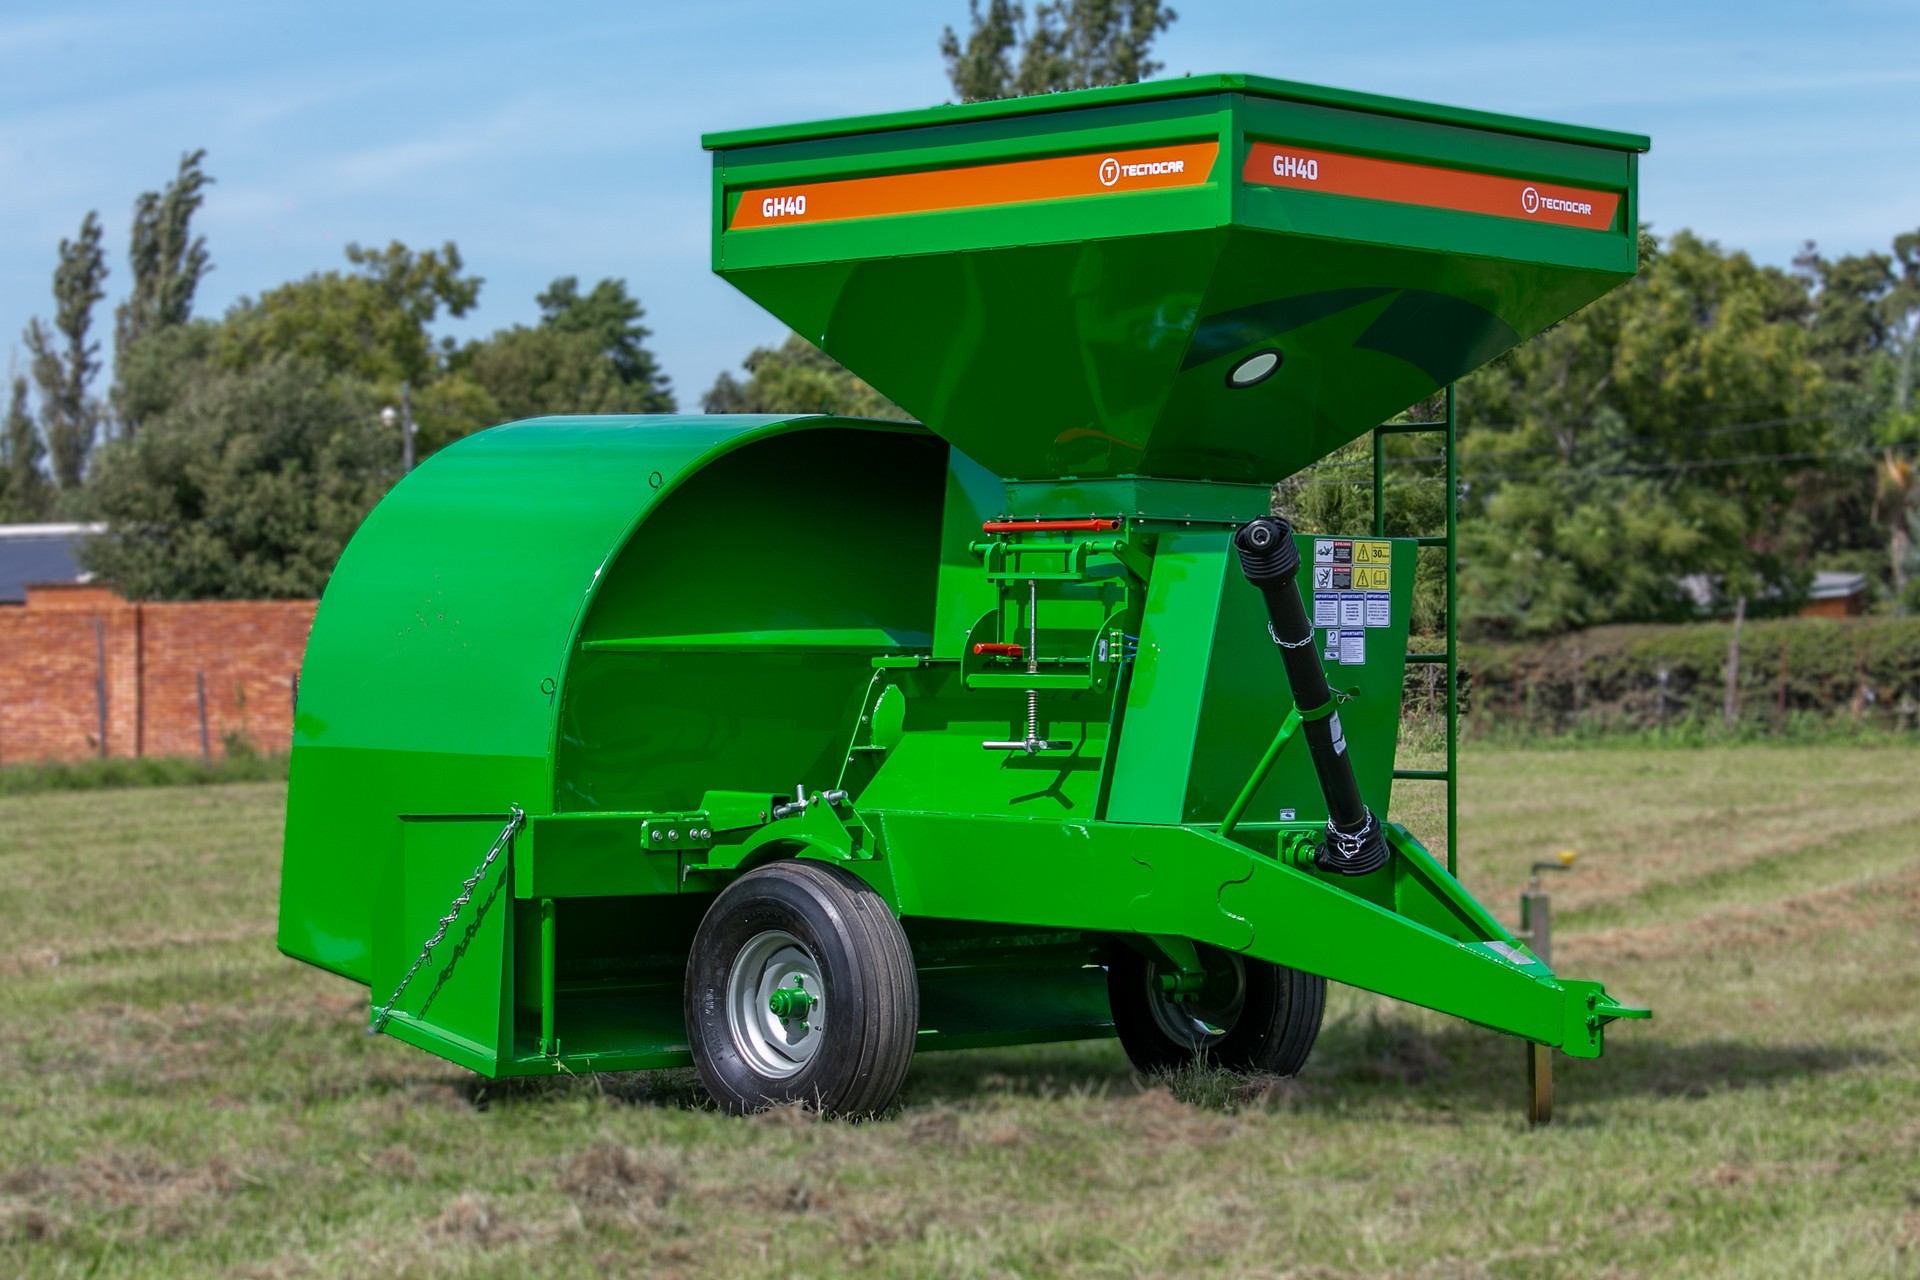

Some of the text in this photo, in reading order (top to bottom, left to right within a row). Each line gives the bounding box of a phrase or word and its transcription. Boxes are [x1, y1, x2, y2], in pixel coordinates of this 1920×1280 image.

[1121, 160, 1185, 178] TECNOCAR
[1273, 155, 1318, 181] GH40
[762, 195, 806, 218] GH40
[1540, 197, 1592, 216] TECNOCAR
[1373, 549, 1383, 558] 30
